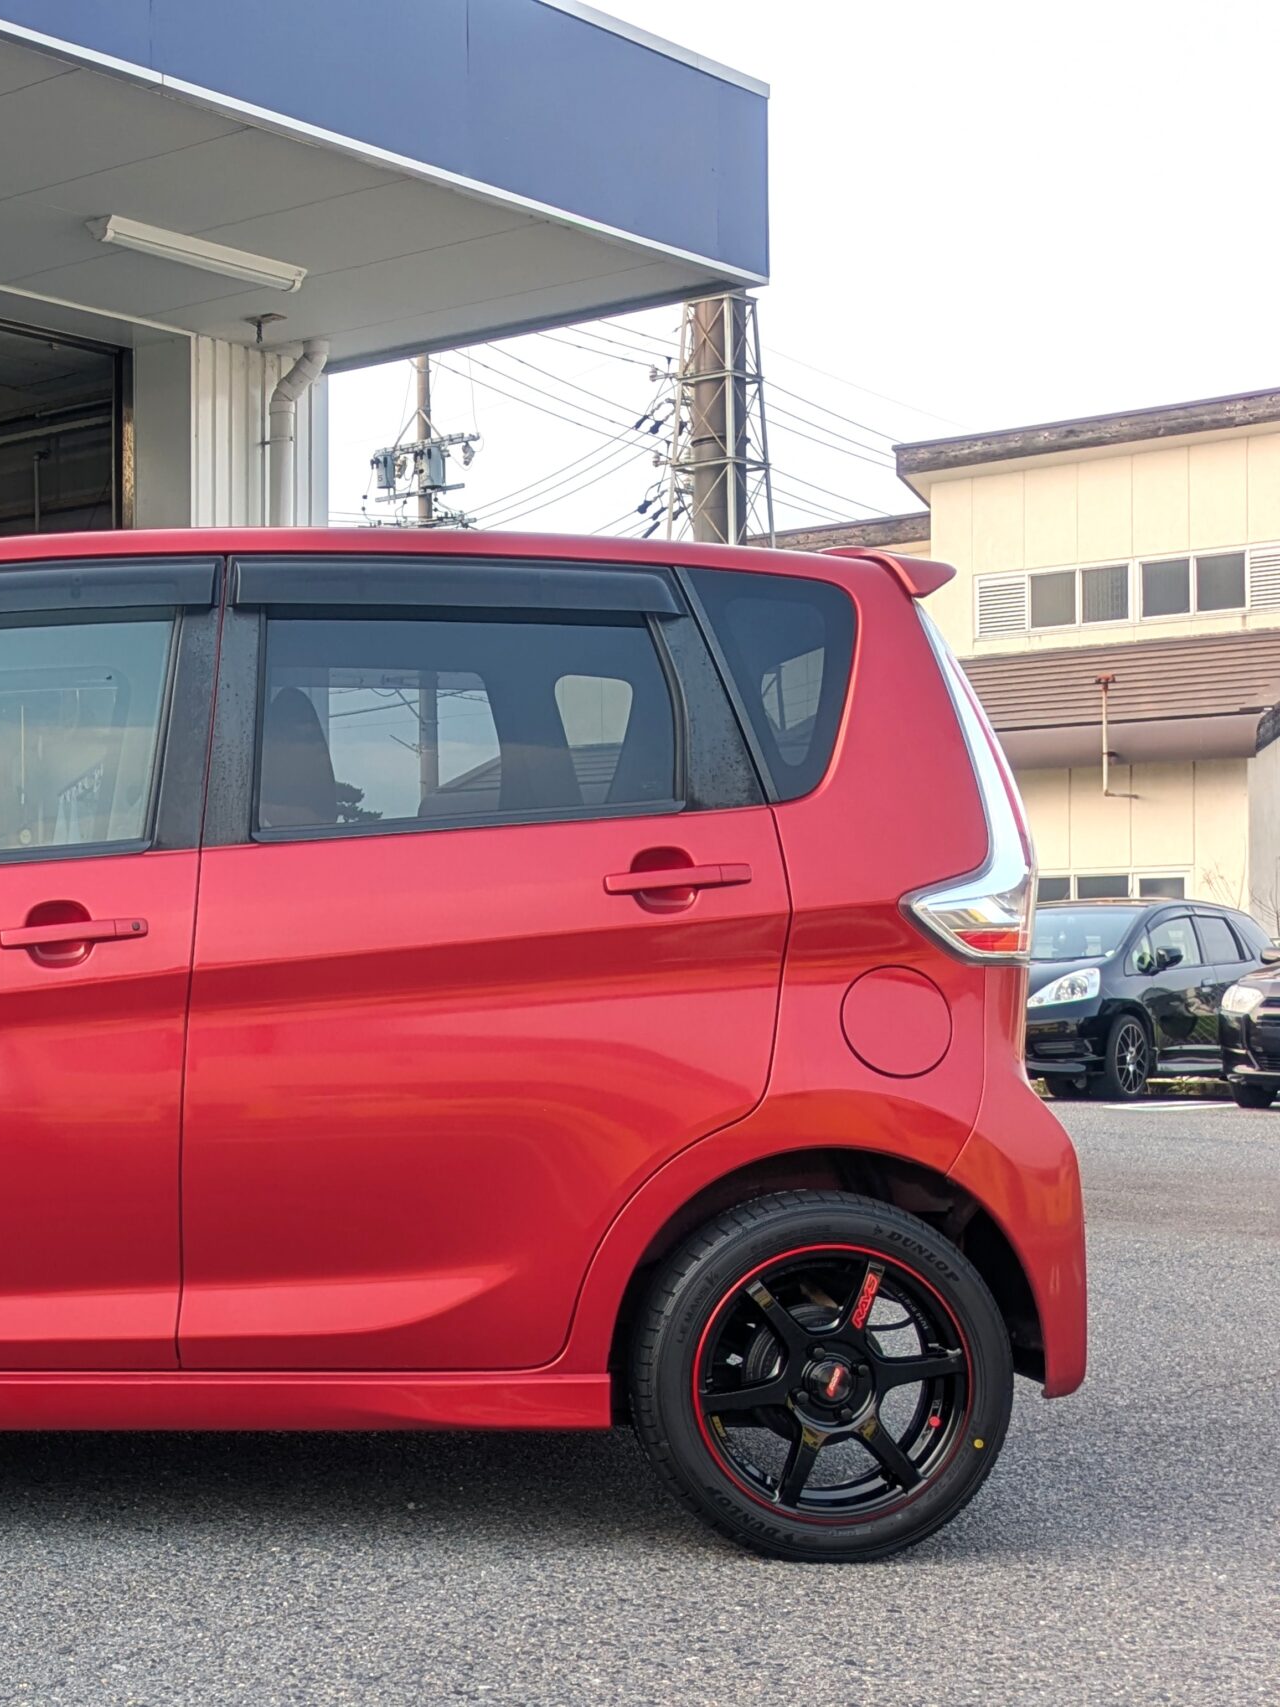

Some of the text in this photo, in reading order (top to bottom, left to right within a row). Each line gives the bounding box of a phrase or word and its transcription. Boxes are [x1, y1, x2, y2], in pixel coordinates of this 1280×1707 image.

[888, 1230, 960, 1284] DUNLOP
[850, 1272, 880, 1331] RAYS
[706, 1485, 780, 1543] DUNLOP
